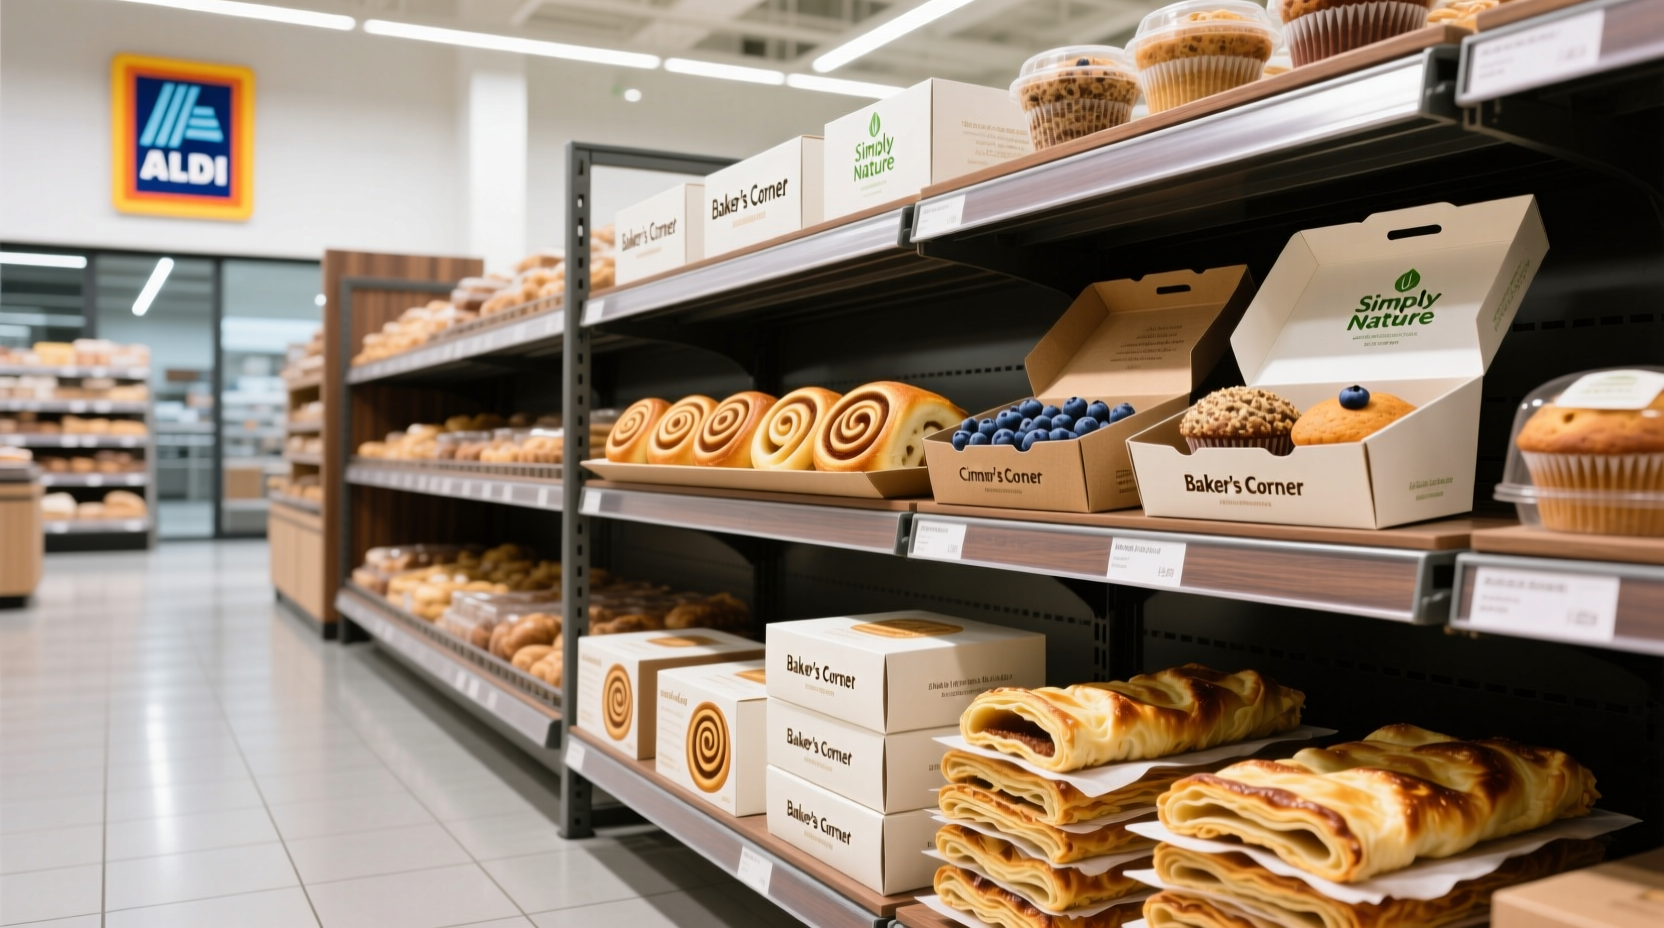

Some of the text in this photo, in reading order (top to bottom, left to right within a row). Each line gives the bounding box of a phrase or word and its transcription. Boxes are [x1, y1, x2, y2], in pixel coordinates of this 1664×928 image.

[855, 132, 894, 162] Simply
[139, 149, 228, 187] ALDI
[854, 156, 895, 182] Nature
[750, 178, 788, 206] Corner
[1354, 289, 1442, 314] Simply
[1346, 311, 1435, 331] Nature
[1184, 474, 1304, 496] Baker's Corner
